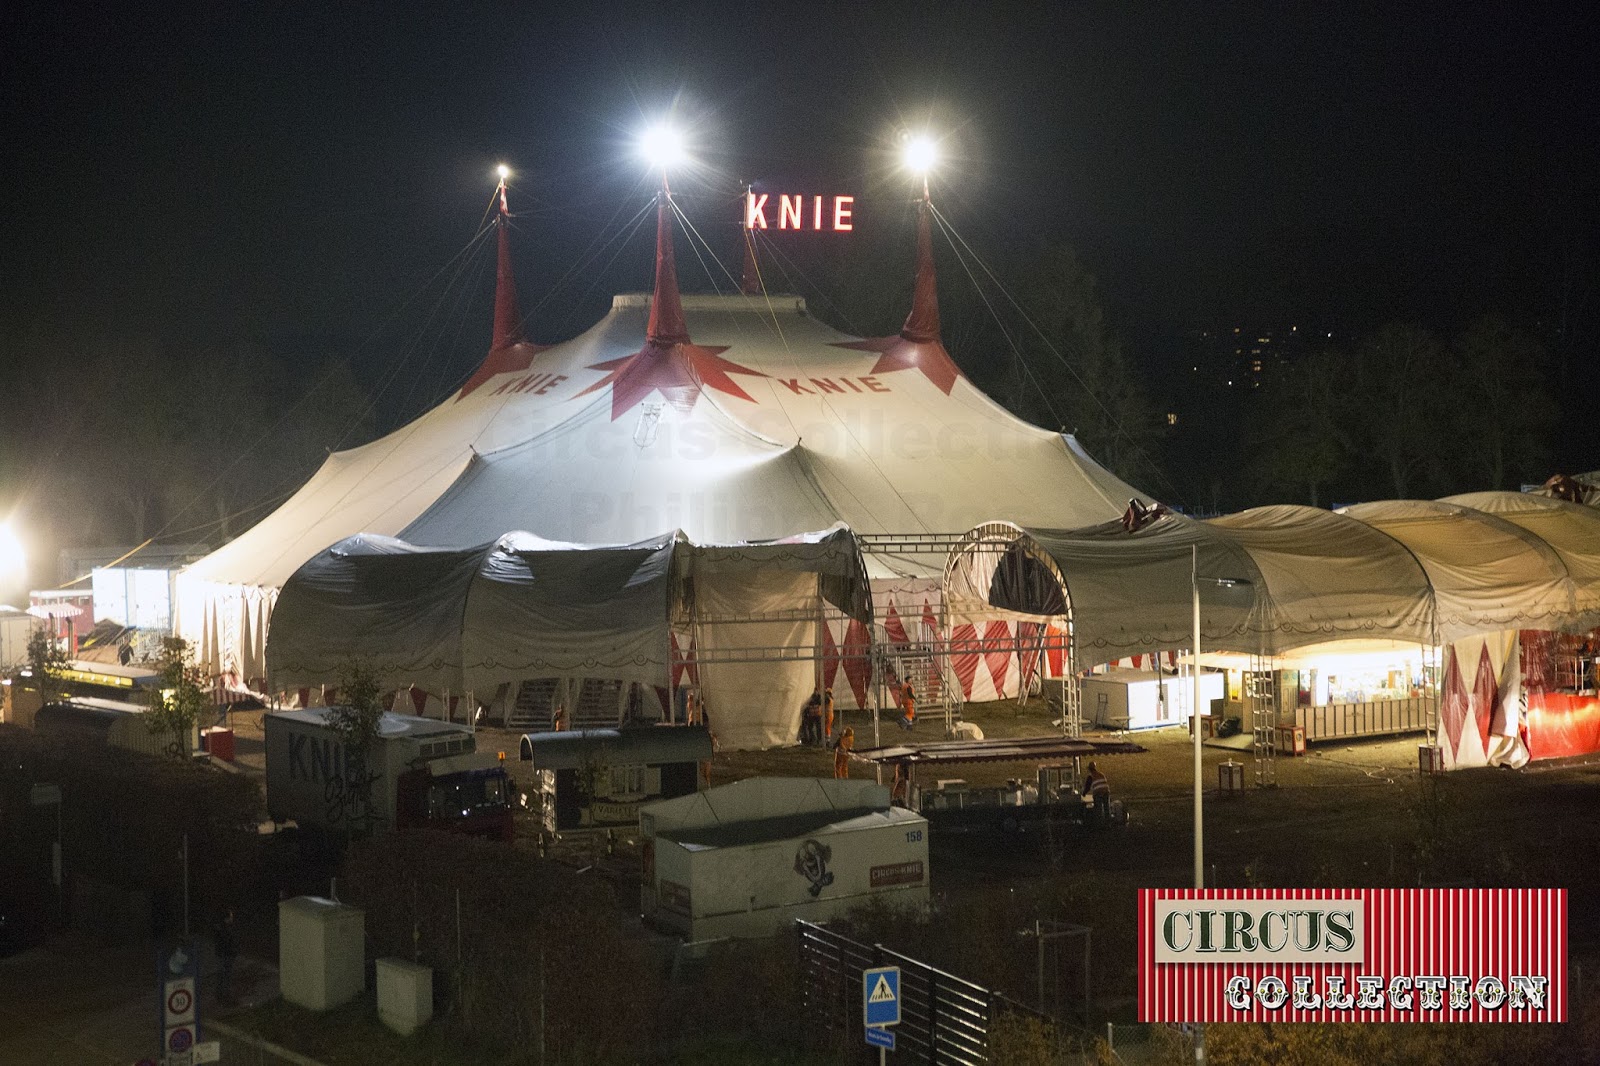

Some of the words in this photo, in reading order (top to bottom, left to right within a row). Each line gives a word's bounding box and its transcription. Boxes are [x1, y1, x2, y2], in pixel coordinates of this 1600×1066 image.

[745, 193, 855, 232] KNIE
[488, 373, 569, 397] KNIE
[776, 376, 892, 396] KNIE
[905, 830, 923, 843] 158
[871, 867, 898, 881] CIRCUS
[899, 863, 923, 875] KNIE
